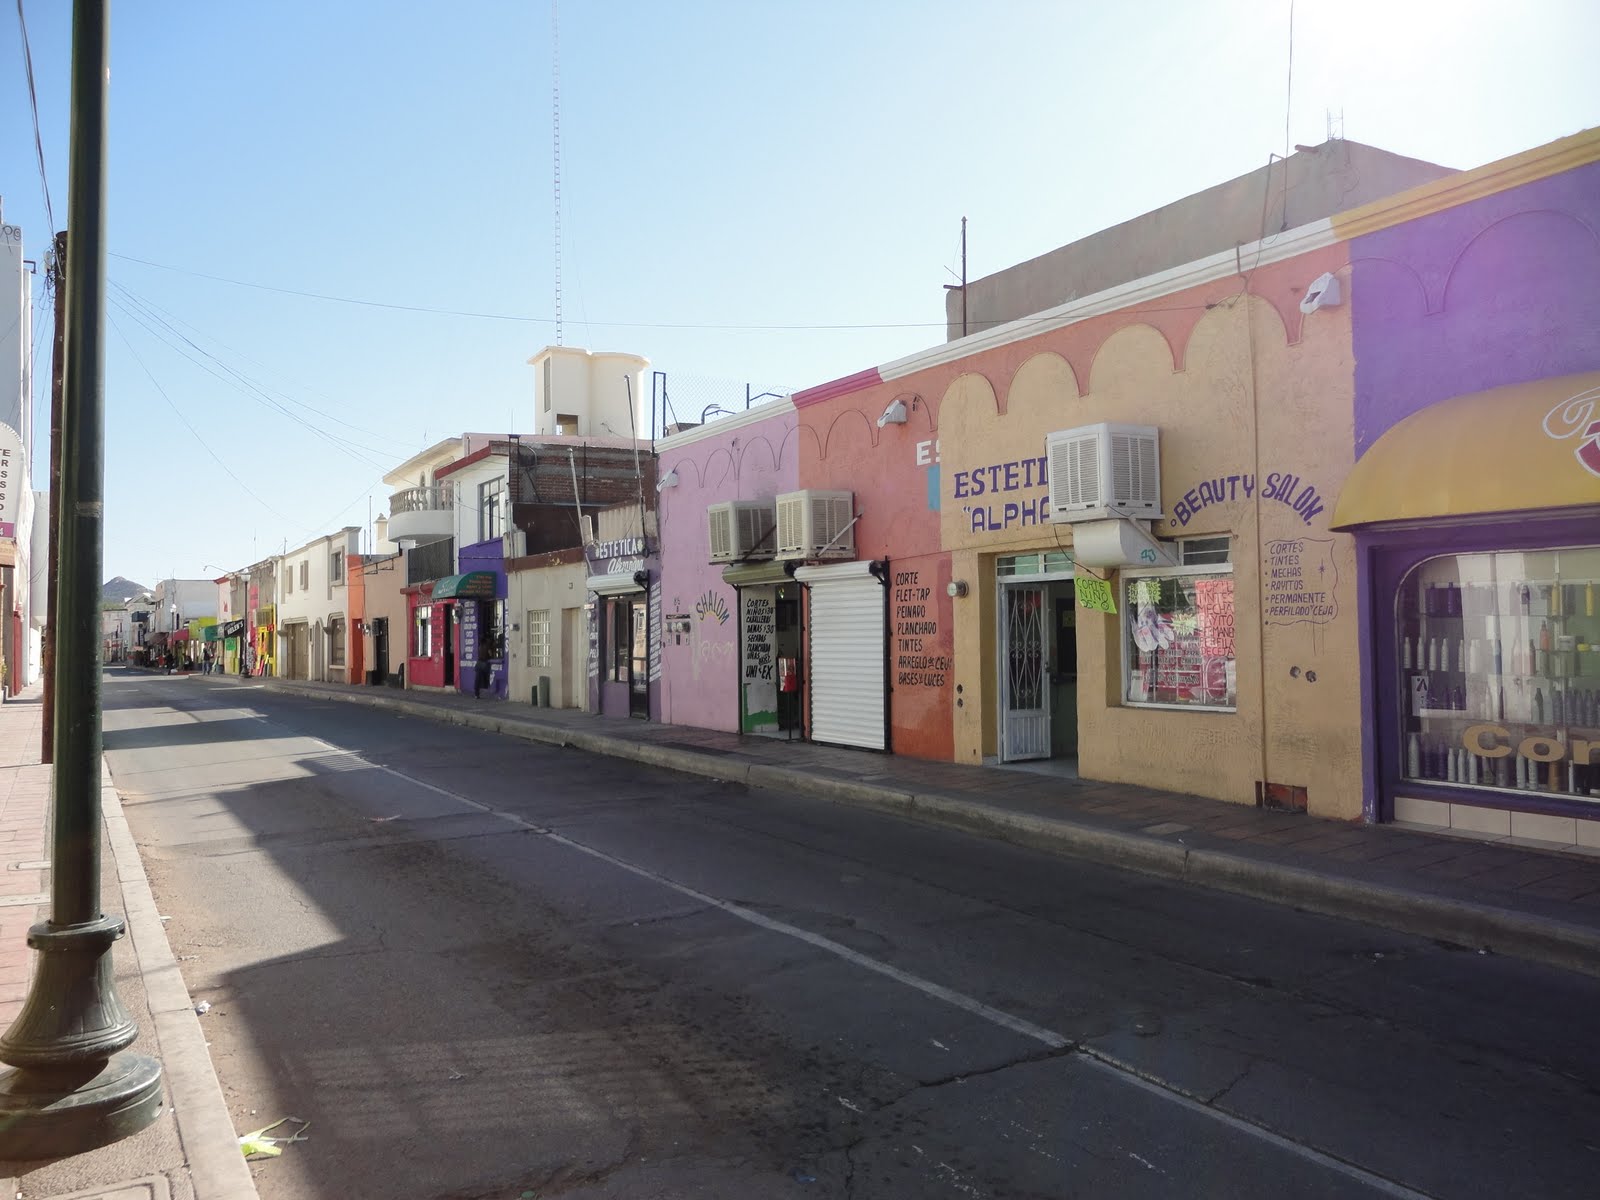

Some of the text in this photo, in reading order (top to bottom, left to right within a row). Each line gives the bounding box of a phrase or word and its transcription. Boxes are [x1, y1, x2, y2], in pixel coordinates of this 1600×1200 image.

[953, 456, 1048, 499] ESTETI
[1173, 474, 1256, 527] BEAUTY
[599, 538, 638, 559] ESTETICA
[1270, 541, 1304, 555] CORTES
[1270, 555, 1299, 566] TINTES
[895, 571, 919, 586] CORTE
[1270, 567, 1302, 578] MECHAS
[1076, 577, 1105, 592] CORTE
[1270, 579, 1304, 591] RAYITOS
[1270, 592, 1326, 604] PERMANENTE
[696, 590, 730, 626] SHALOM
[896, 605, 926, 619] PEINADO
[1269, 605, 1310, 616] PERFILADO
[1312, 605, 1334, 616] CEJA
[897, 621, 937, 636] PLANCHADO
[898, 638, 923, 653] TINTES
[898, 655, 928, 670] ARREGLO
[898, 672, 919, 686] BASES
